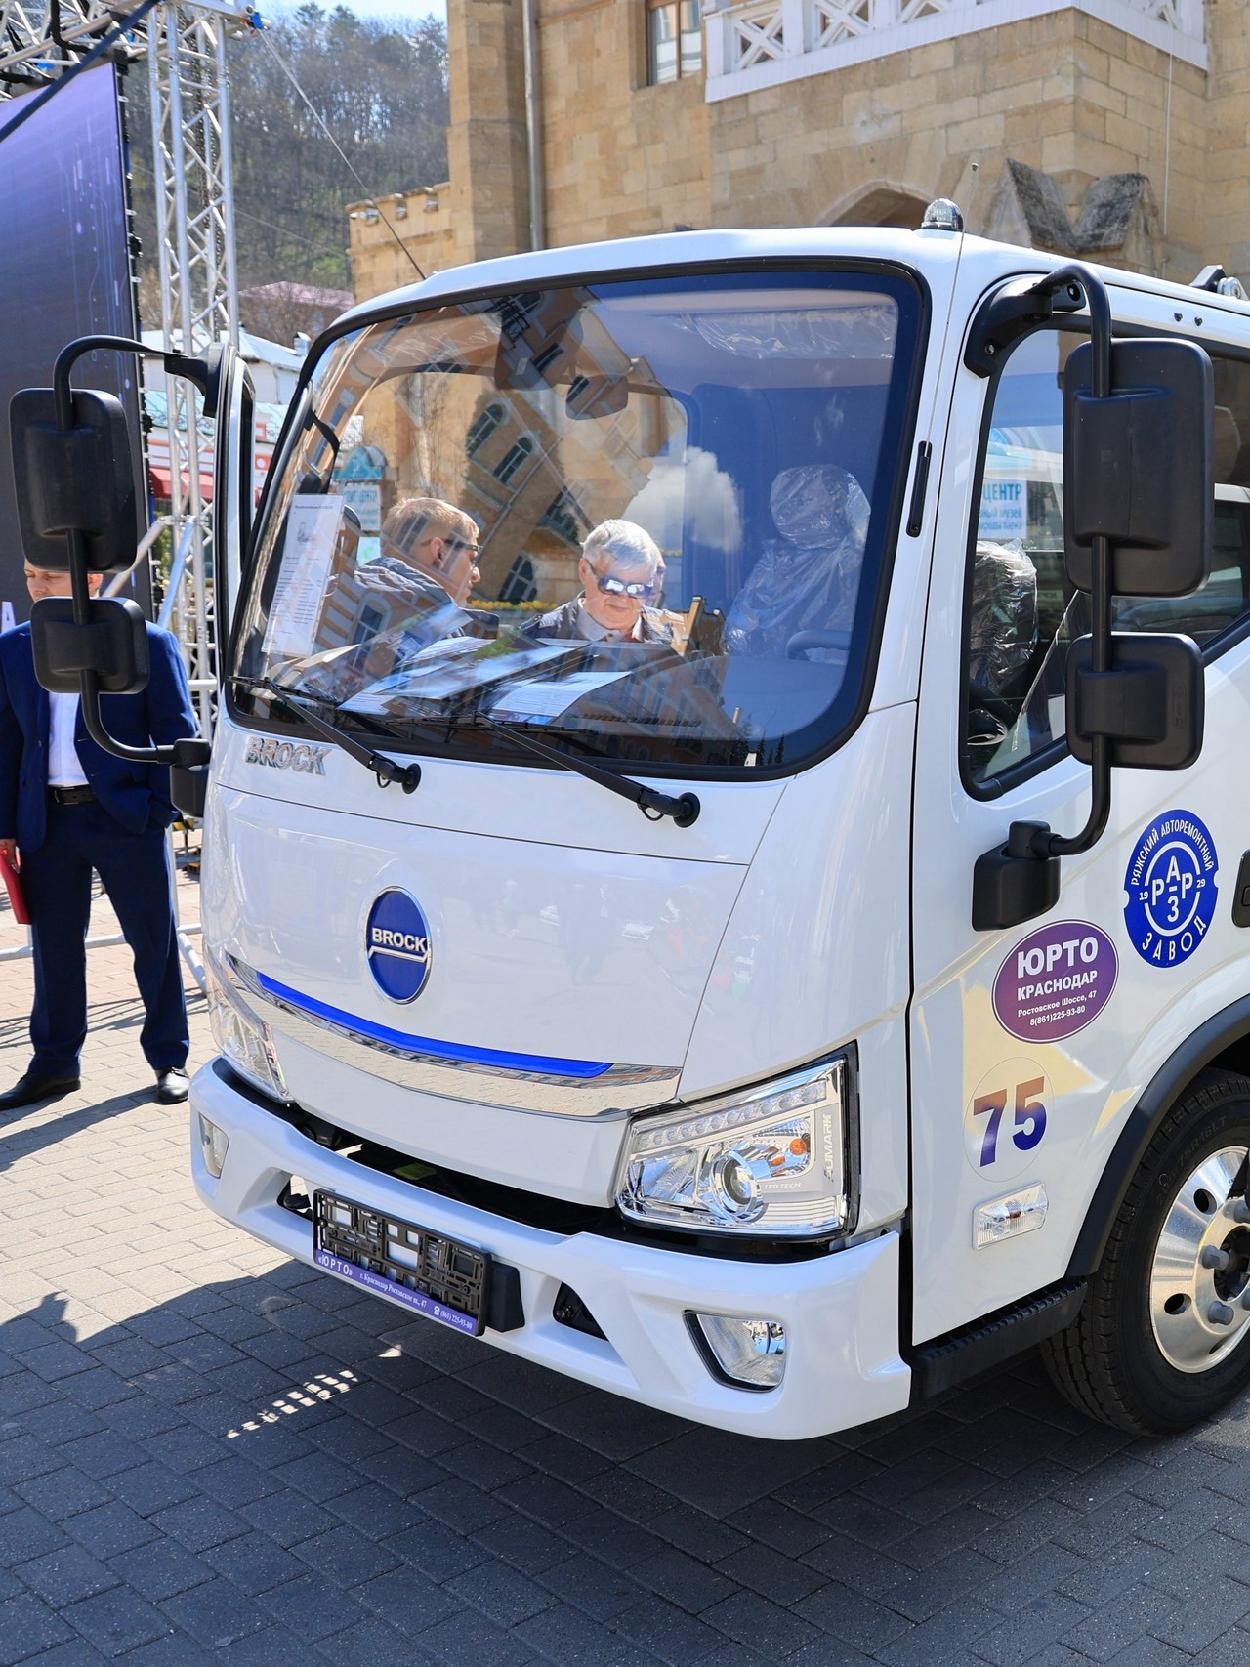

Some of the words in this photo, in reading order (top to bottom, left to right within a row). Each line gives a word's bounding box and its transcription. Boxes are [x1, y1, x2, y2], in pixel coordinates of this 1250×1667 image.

[246, 736, 333, 776] BROCK
[1131, 828, 1160, 886] РЯЖСКИЙ
[1160, 819, 1214, 871] АВТОРЕМОНТНЫЙ
[372, 927, 426, 953] BROCK
[1017, 936, 1099, 979] ЮРТО
[1142, 916, 1207, 960] ЗАВОД
[1017, 970, 1098, 1001] КРАСНОДАР
[1018, 1001, 1060, 1017] Ростовское
[1088, 990, 1098, 999] 47
[973, 1076, 1047, 1167] 75
